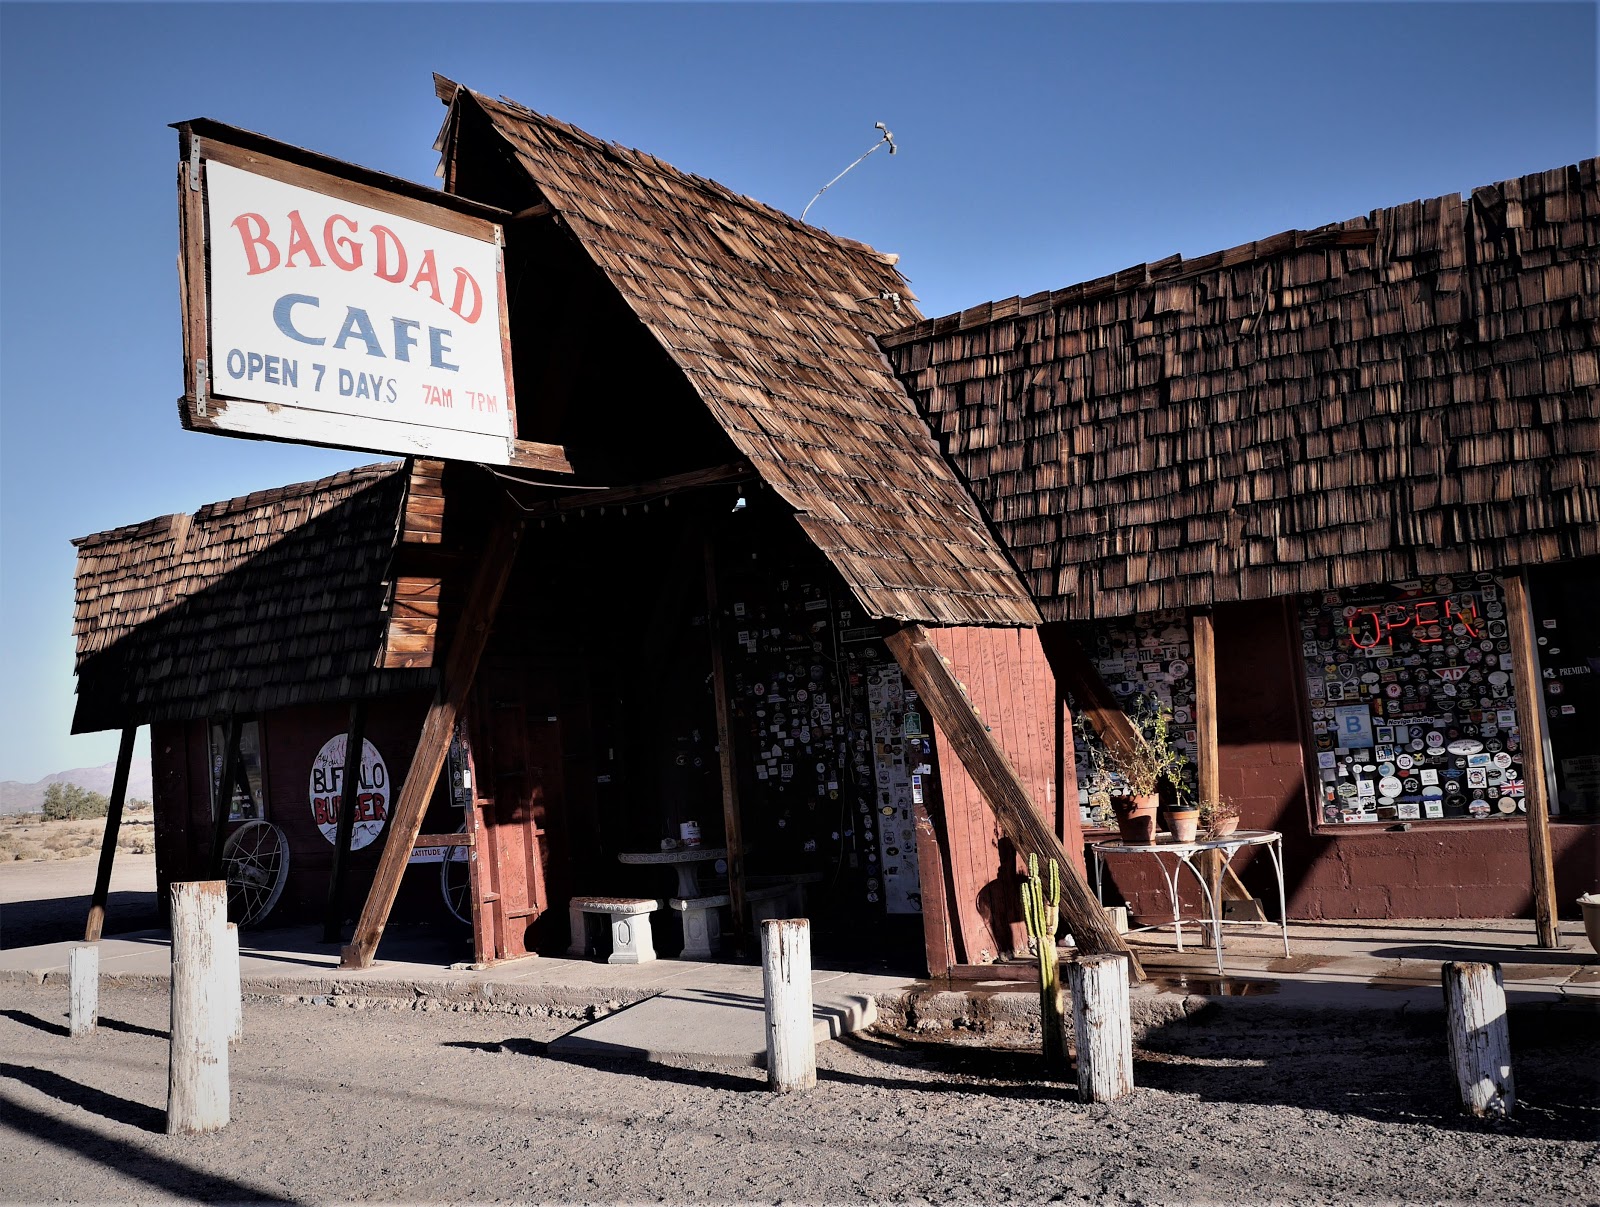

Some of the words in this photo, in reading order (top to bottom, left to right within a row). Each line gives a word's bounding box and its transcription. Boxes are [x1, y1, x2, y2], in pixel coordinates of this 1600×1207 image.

[231, 209, 483, 324] BAGDAD
[272, 293, 460, 373] CAFE
[226, 348, 298, 389] OPEN
[312, 363, 326, 392] 7
[338, 368, 398, 404] DAYS
[421, 384, 453, 409] 7AM
[465, 390, 498, 414] 7PM
[1349, 600, 1479, 649] OPEN
[1442, 669, 1463, 681] AD
[1559, 666, 1591, 677] PREMIUM
[1345, 716, 1361, 733] B
[1412, 717, 1434, 725] Racing
[313, 763, 385, 793] BUFLO
[411, 848, 441, 858] LATITUDE
